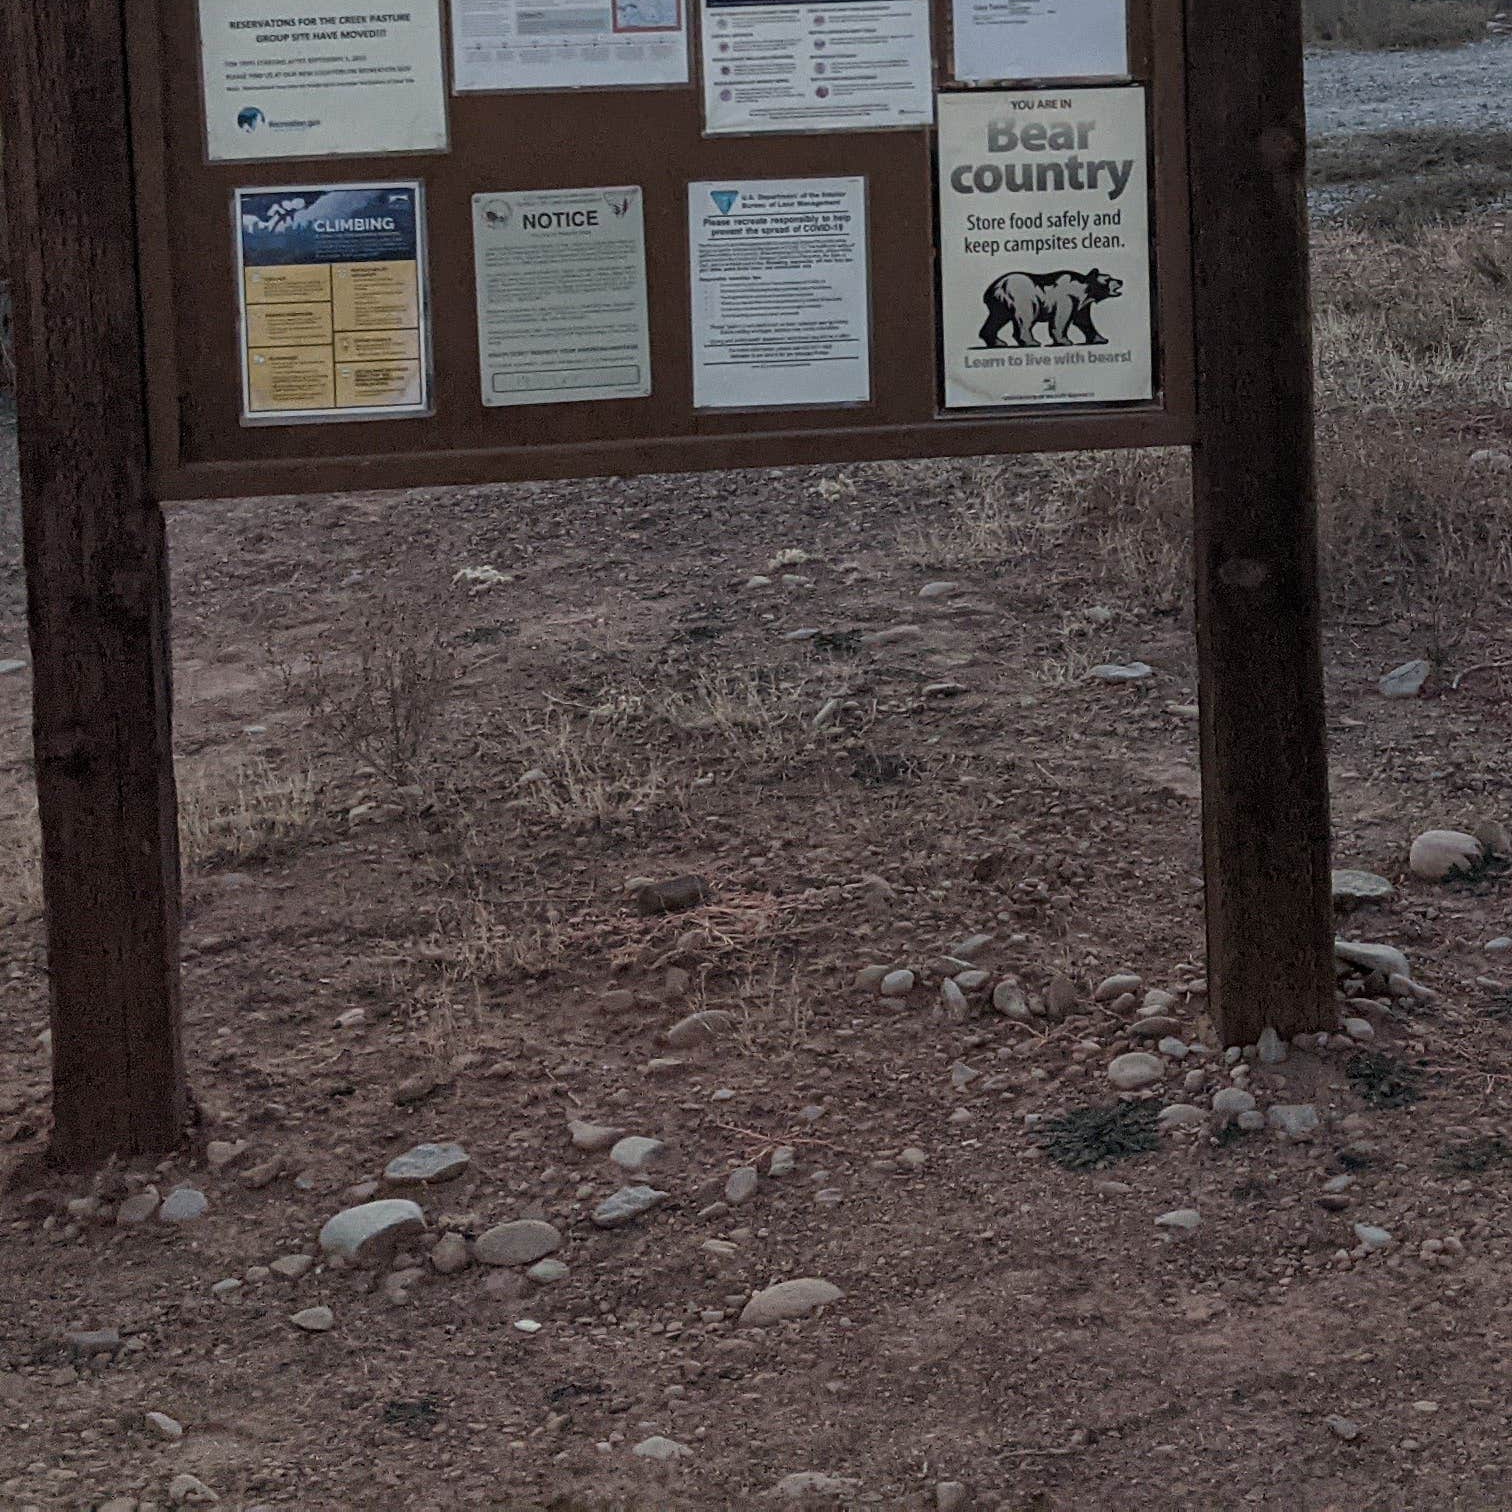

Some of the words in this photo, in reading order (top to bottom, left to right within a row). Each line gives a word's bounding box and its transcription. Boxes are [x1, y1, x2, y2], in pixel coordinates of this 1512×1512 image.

[298, 17, 316, 27] FOR
[319, 16, 336, 26] THE
[313, 31, 337, 40] HAVE
[1011, 100, 1035, 110] YOU
[1037, 99, 1058, 109] ARE
[1060, 99, 1072, 108] IN
[987, 117, 1096, 153] Bear
[950, 155, 1134, 201] country
[314, 217, 395, 233] CLIMBING
[523, 210, 600, 230] NOTICE
[703, 218, 730, 227] Please
[771, 215, 819, 226] responsibly
[833, 214, 851, 223] help
[967, 214, 1006, 231] Store
[1010, 213, 1042, 229] food
[1047, 210, 1090, 230] safely
[1093, 209, 1121, 226] and
[746, 227, 759, 235] the
[762, 226, 790, 236] spread
[964, 238, 999, 256] keep
[1004, 235, 1078, 254] campsites
[1081, 233, 1125, 249] clean.
[964, 355, 1005, 369] Learn
[1008, 354, 1023, 366] to
[1026, 353, 1050, 366] live
[1054, 351, 1085, 365] with
[1088, 350, 1131, 364] bears!
